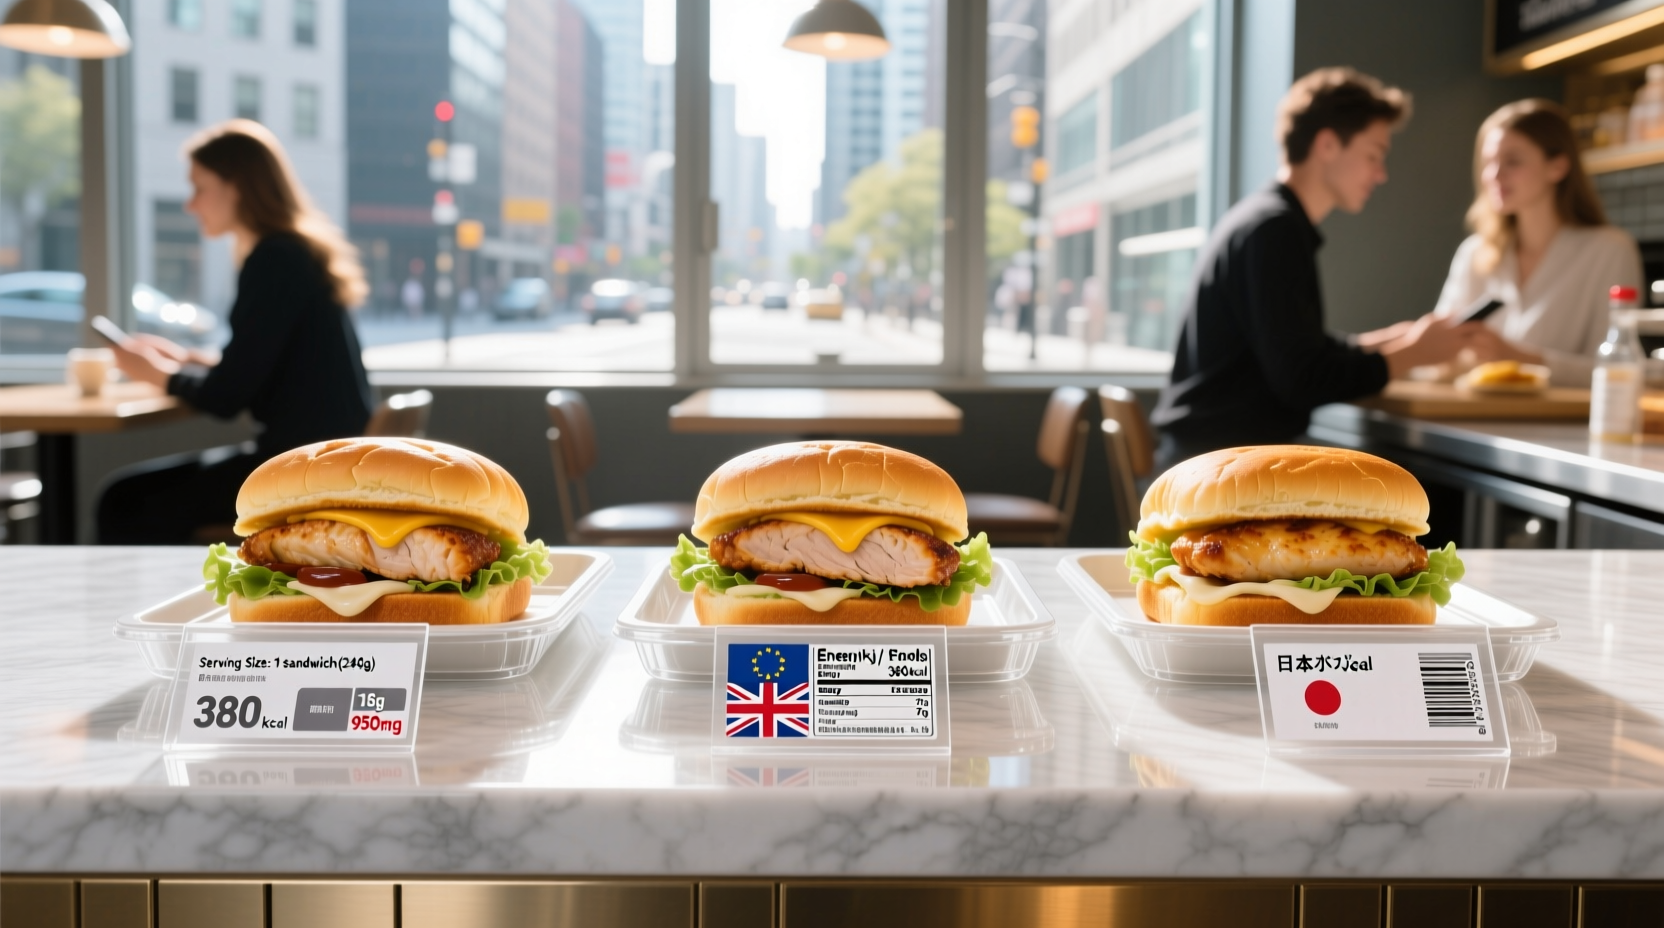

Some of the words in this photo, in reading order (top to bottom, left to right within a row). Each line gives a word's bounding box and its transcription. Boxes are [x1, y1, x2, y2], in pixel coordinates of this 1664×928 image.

[199, 657, 242, 671] Serving
[245, 657, 271, 668] Size:
[274, 657, 280, 668] 1
[357, 693, 385, 711] 16g
[193, 695, 262, 729] 380
[261, 716, 288, 729] kcal
[351, 715, 402, 735] 950mg
